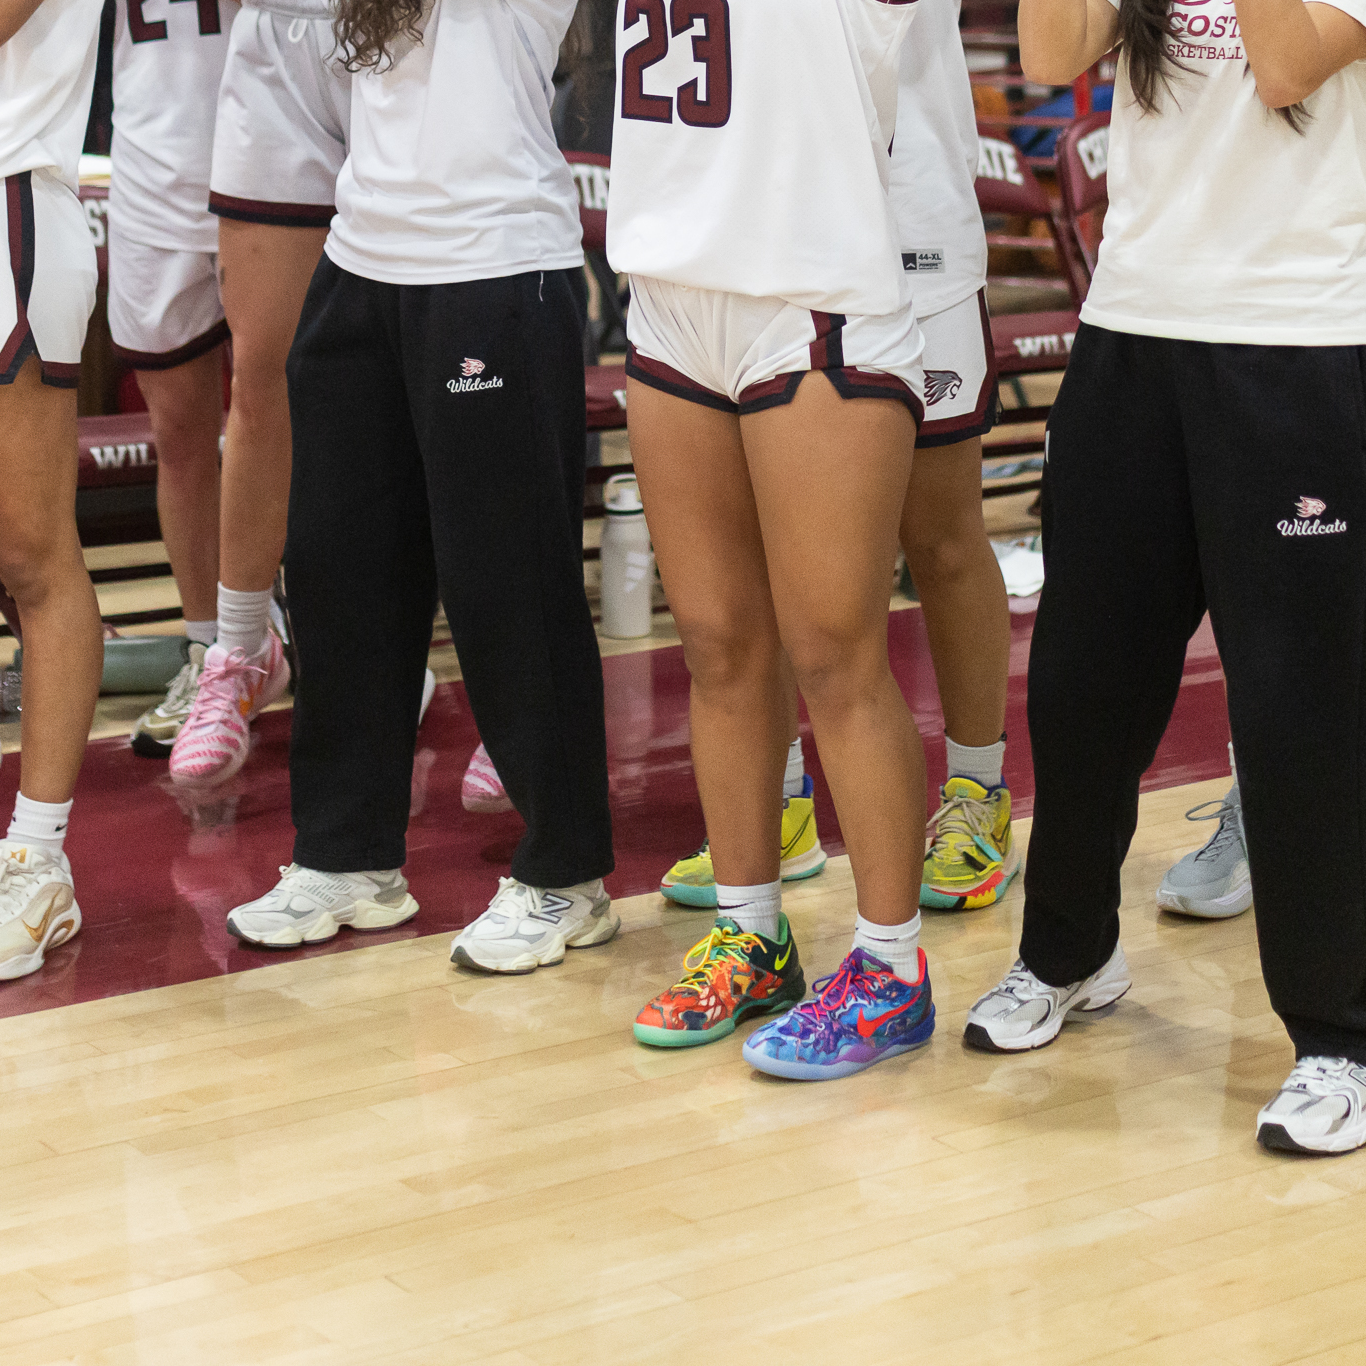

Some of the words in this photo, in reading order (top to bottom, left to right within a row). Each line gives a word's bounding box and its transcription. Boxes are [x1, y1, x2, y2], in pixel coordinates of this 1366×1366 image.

[1167, 44, 1244, 60] SKETBALL
[918, 253, 942, 261] 44-XL
[446, 375, 504, 394] Wildcats
[1276, 518, 1348, 536] Wildcats
